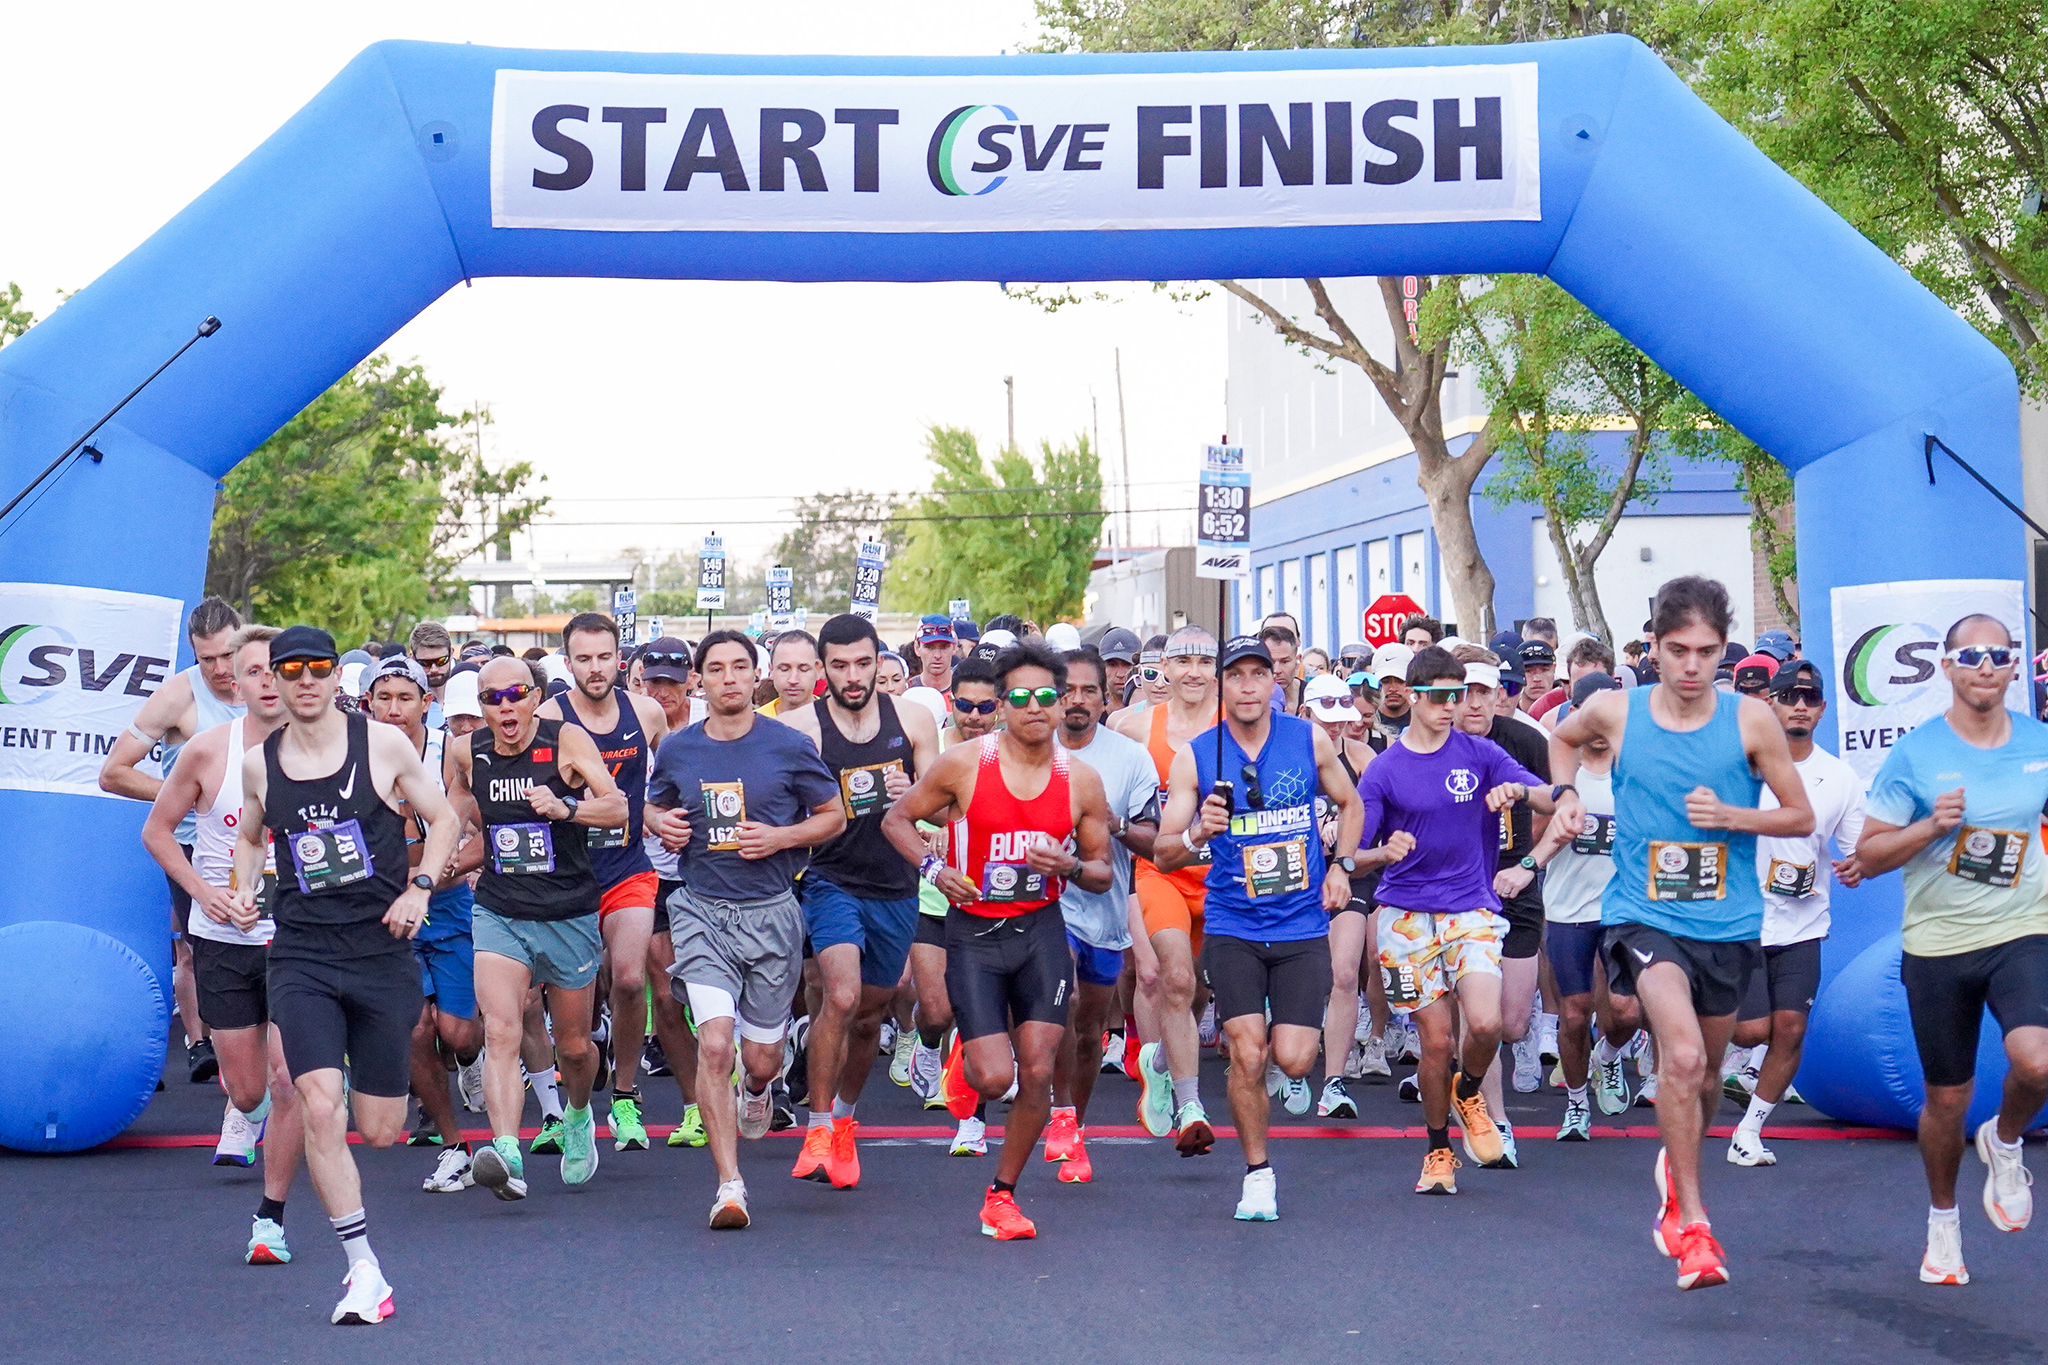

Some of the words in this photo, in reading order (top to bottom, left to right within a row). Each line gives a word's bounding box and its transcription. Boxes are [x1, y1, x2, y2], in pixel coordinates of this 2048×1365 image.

[531, 103, 899, 192] START
[971, 123, 1111, 173] SVE
[1137, 97, 1503, 189] FINISH
[1207, 446, 1243, 464] RUN
[1204, 486, 1244, 509] 1:30
[1202, 512, 1245, 537] 6:52
[862, 543, 881, 555] RUN
[703, 559, 722, 570] 1:45
[857, 567, 879, 583] 3:20
[702, 573, 722, 586] 8:01
[855, 583, 876, 599] 7:38
[617, 613, 635, 627] 3:30
[1367, 612, 1407, 638] STO
[18, 645, 170, 698] SVE
[0, 726, 57, 750] ENT
[66, 731, 163, 762] TIMG
[298, 804, 338, 820] TCLA
[334, 834, 360, 864] 187
[528, 830, 546, 858] 251
[1999, 833, 2023, 874] 1857
[1286, 843, 1304, 880] 1858
[1698, 846, 1718, 887] 1350
[1026, 873, 1041, 891] 69
[1398, 965, 1416, 1000] 1056
